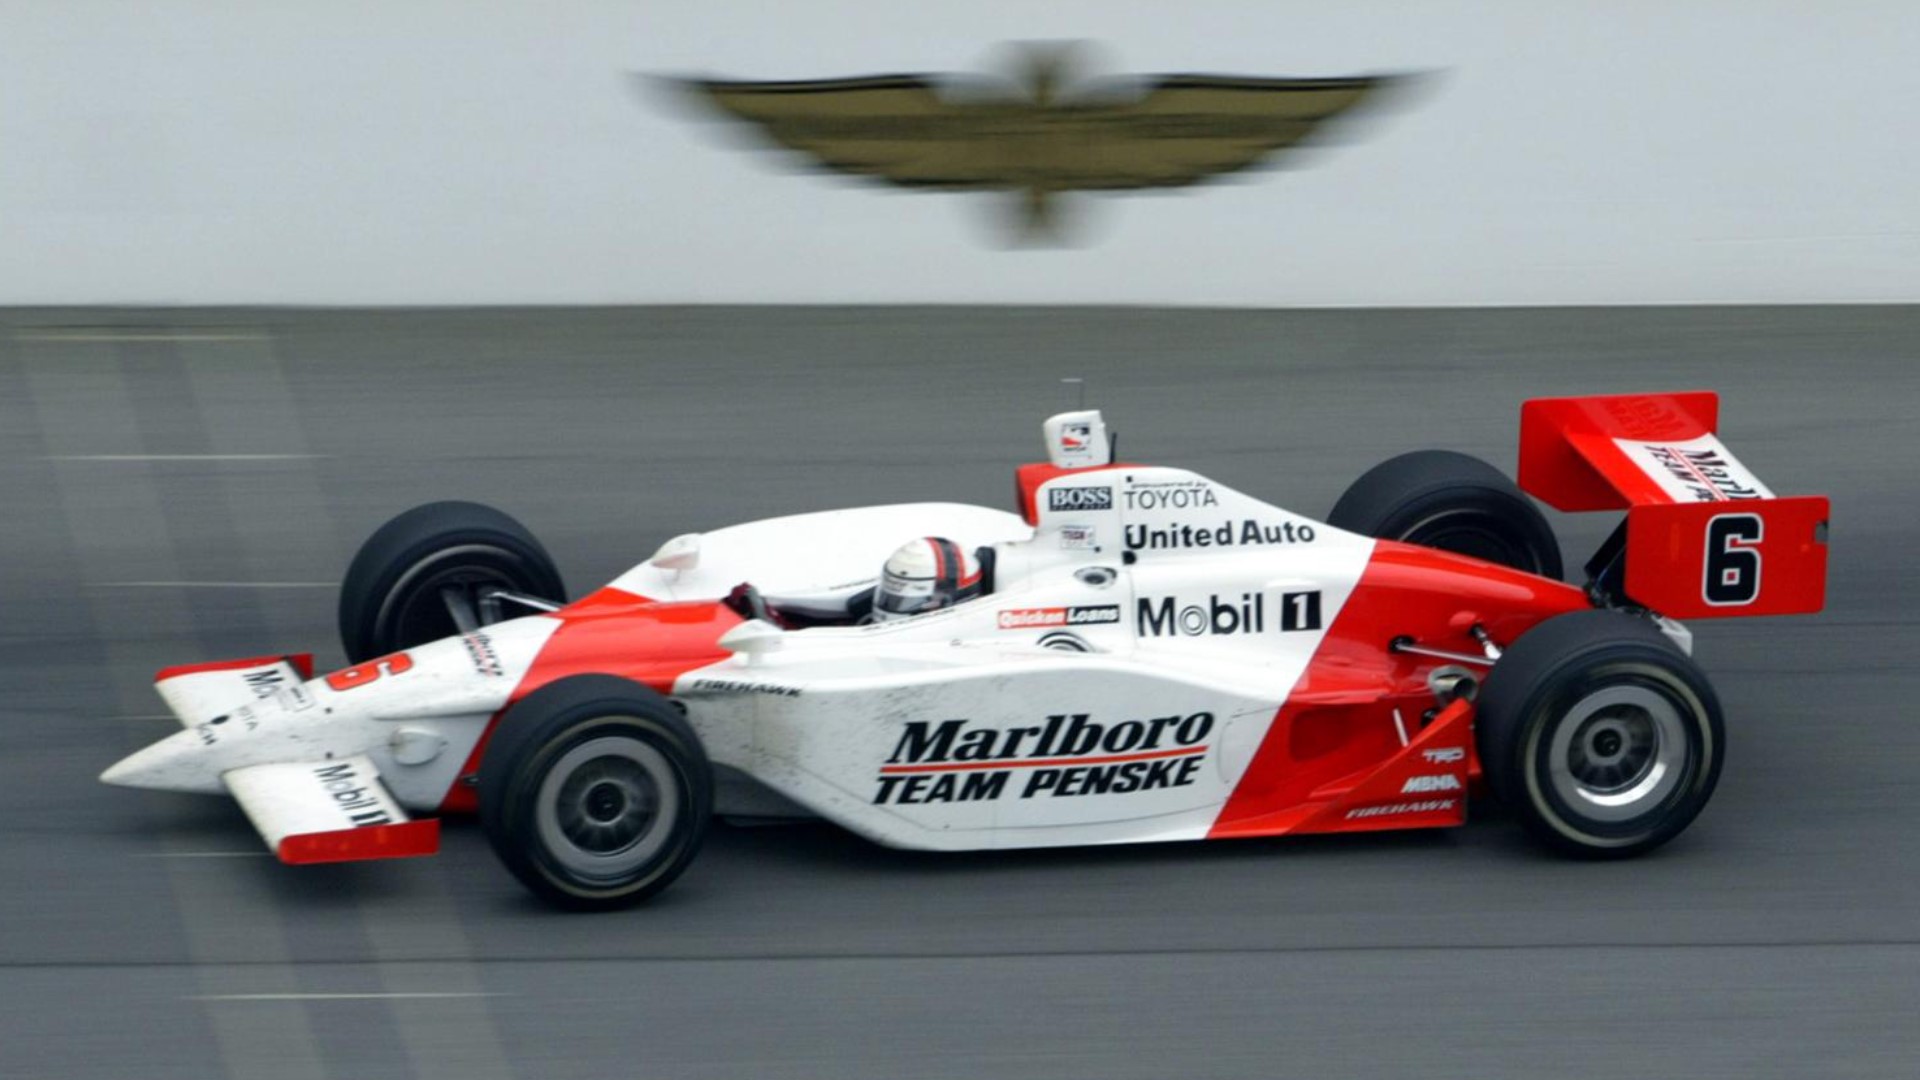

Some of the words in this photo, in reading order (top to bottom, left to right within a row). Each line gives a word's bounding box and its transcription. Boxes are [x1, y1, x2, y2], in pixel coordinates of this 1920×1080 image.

[1051, 488, 1110, 506] BOSS
[1123, 489, 1218, 509] TOYOTA
[1125, 520, 1233, 550] United
[1240, 520, 1315, 544] Auto
[1702, 512, 1764, 607] 6
[998, 608, 1066, 628] Quicken
[1067, 606, 1119, 624] Loans
[1137, 592, 1263, 638] Mobil
[1287, 592, 1313, 630] 1
[325, 652, 413, 690] 6
[692, 678, 803, 698] FIREHAWK
[884, 711, 1214, 764] Marlboro
[313, 764, 379, 811] Mobil
[871, 771, 1012, 805] TEAM
[1020, 755, 1206, 799] PENSKE
[1344, 799, 1455, 820] FIREHAWK
